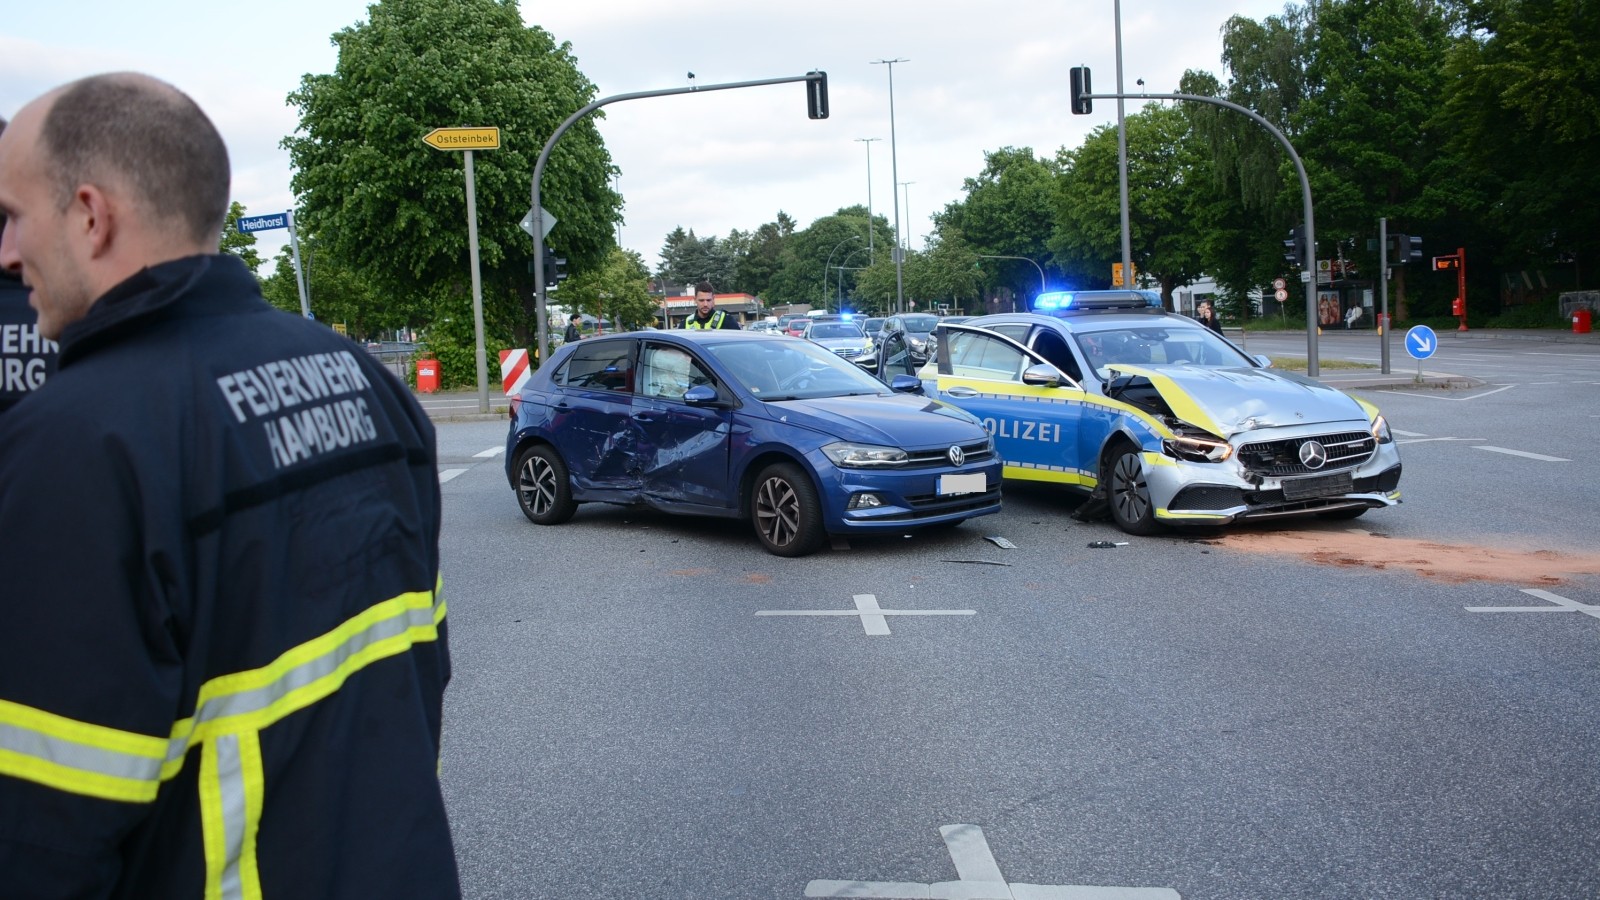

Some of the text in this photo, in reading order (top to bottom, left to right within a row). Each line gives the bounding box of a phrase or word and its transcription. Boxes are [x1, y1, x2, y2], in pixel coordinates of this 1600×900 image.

[436, 134, 494, 144] Oststeinbek
[241, 216, 284, 231] Heidhorst
[216, 350, 370, 423] FEUERWEHR
[264, 397, 377, 469] HAMBURG
